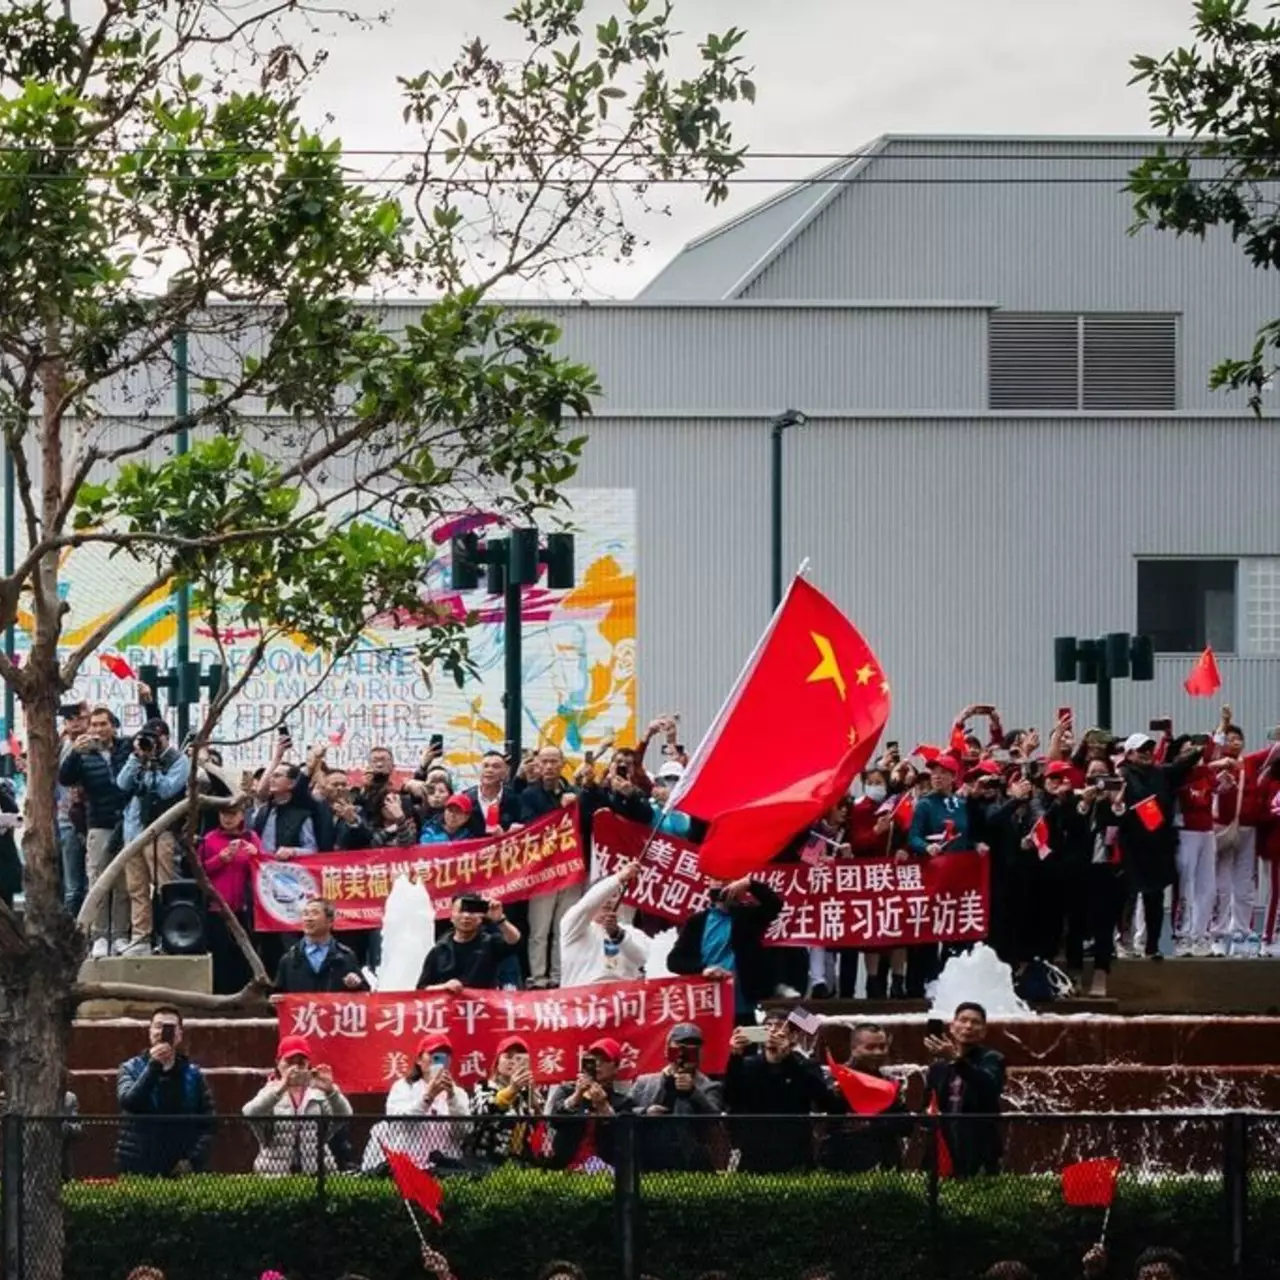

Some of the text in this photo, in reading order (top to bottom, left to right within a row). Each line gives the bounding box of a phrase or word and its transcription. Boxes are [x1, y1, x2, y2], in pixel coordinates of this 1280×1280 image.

[290, 981, 723, 1038] 欢迎习近平主席访问美国
[381, 1042, 642, 1081] 美武家会
